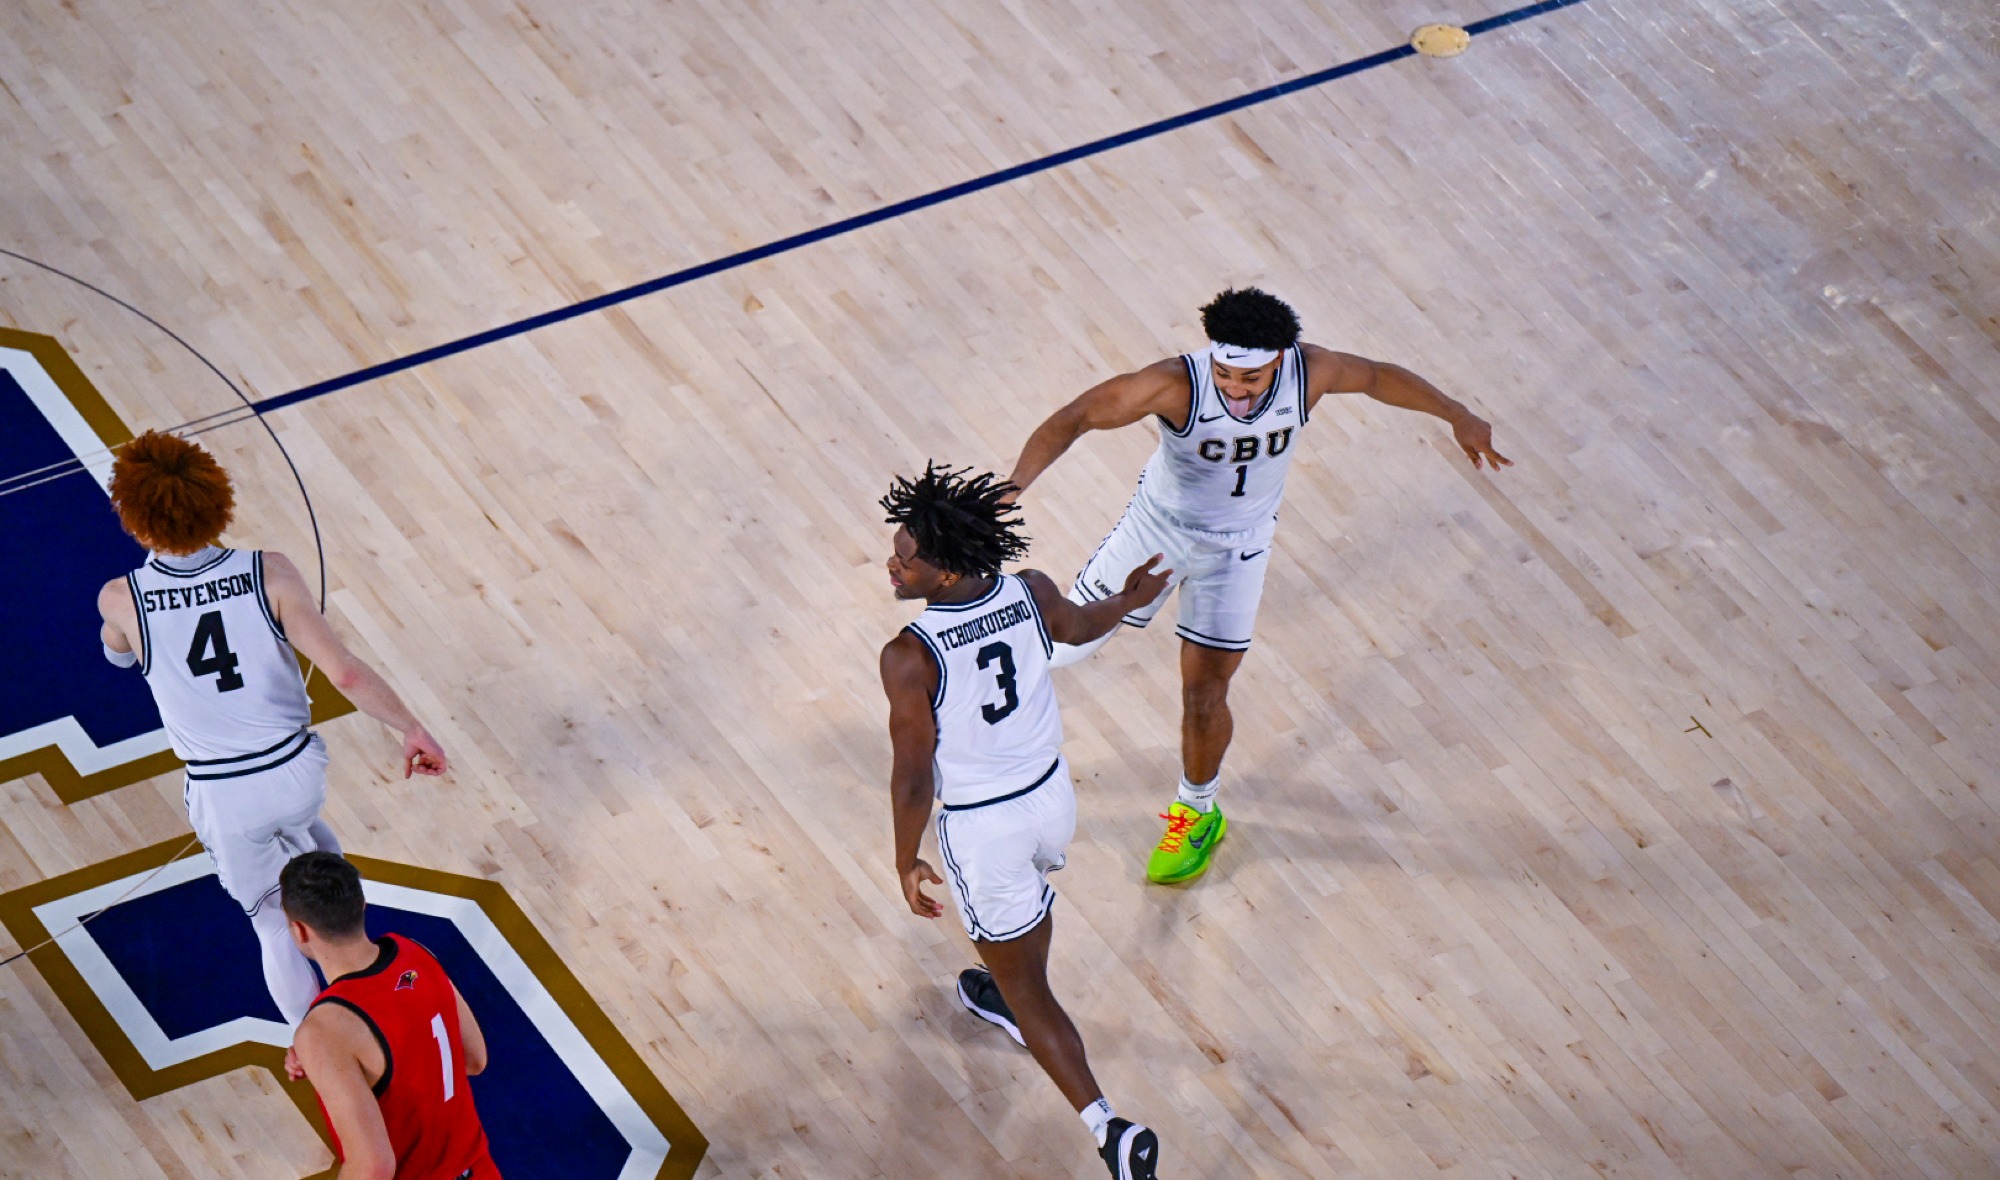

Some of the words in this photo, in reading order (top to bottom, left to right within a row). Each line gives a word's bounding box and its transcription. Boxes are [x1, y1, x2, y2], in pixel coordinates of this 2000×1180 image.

[1198, 426, 1294, 463] CBU
[1231, 464, 1248, 496] 1
[143, 572, 254, 613] STEVENSON
[936, 600, 1032, 651] TCHOUKUIEGNO
[186, 610, 244, 693] 4
[976, 641, 1019, 725] 3
[431, 1012, 454, 1102] 1
